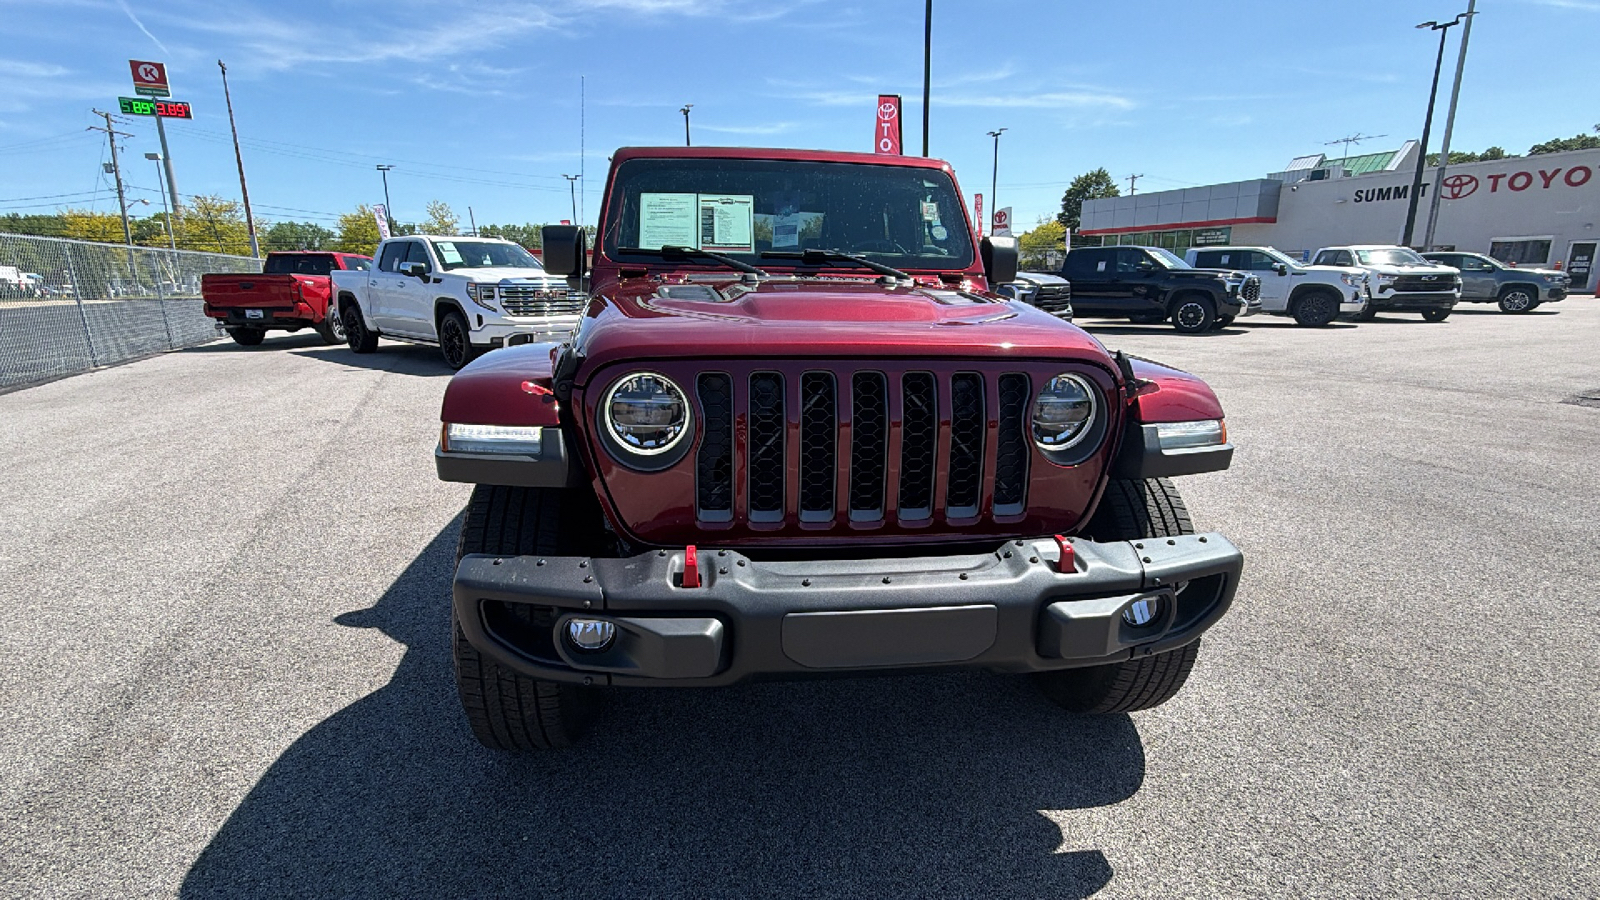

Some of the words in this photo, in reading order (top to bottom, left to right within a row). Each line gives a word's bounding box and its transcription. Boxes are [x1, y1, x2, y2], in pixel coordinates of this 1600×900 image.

[143, 67, 158, 80] K
[1487, 165, 1600, 193] TOYO
[1353, 182, 1430, 203] SUMMT
